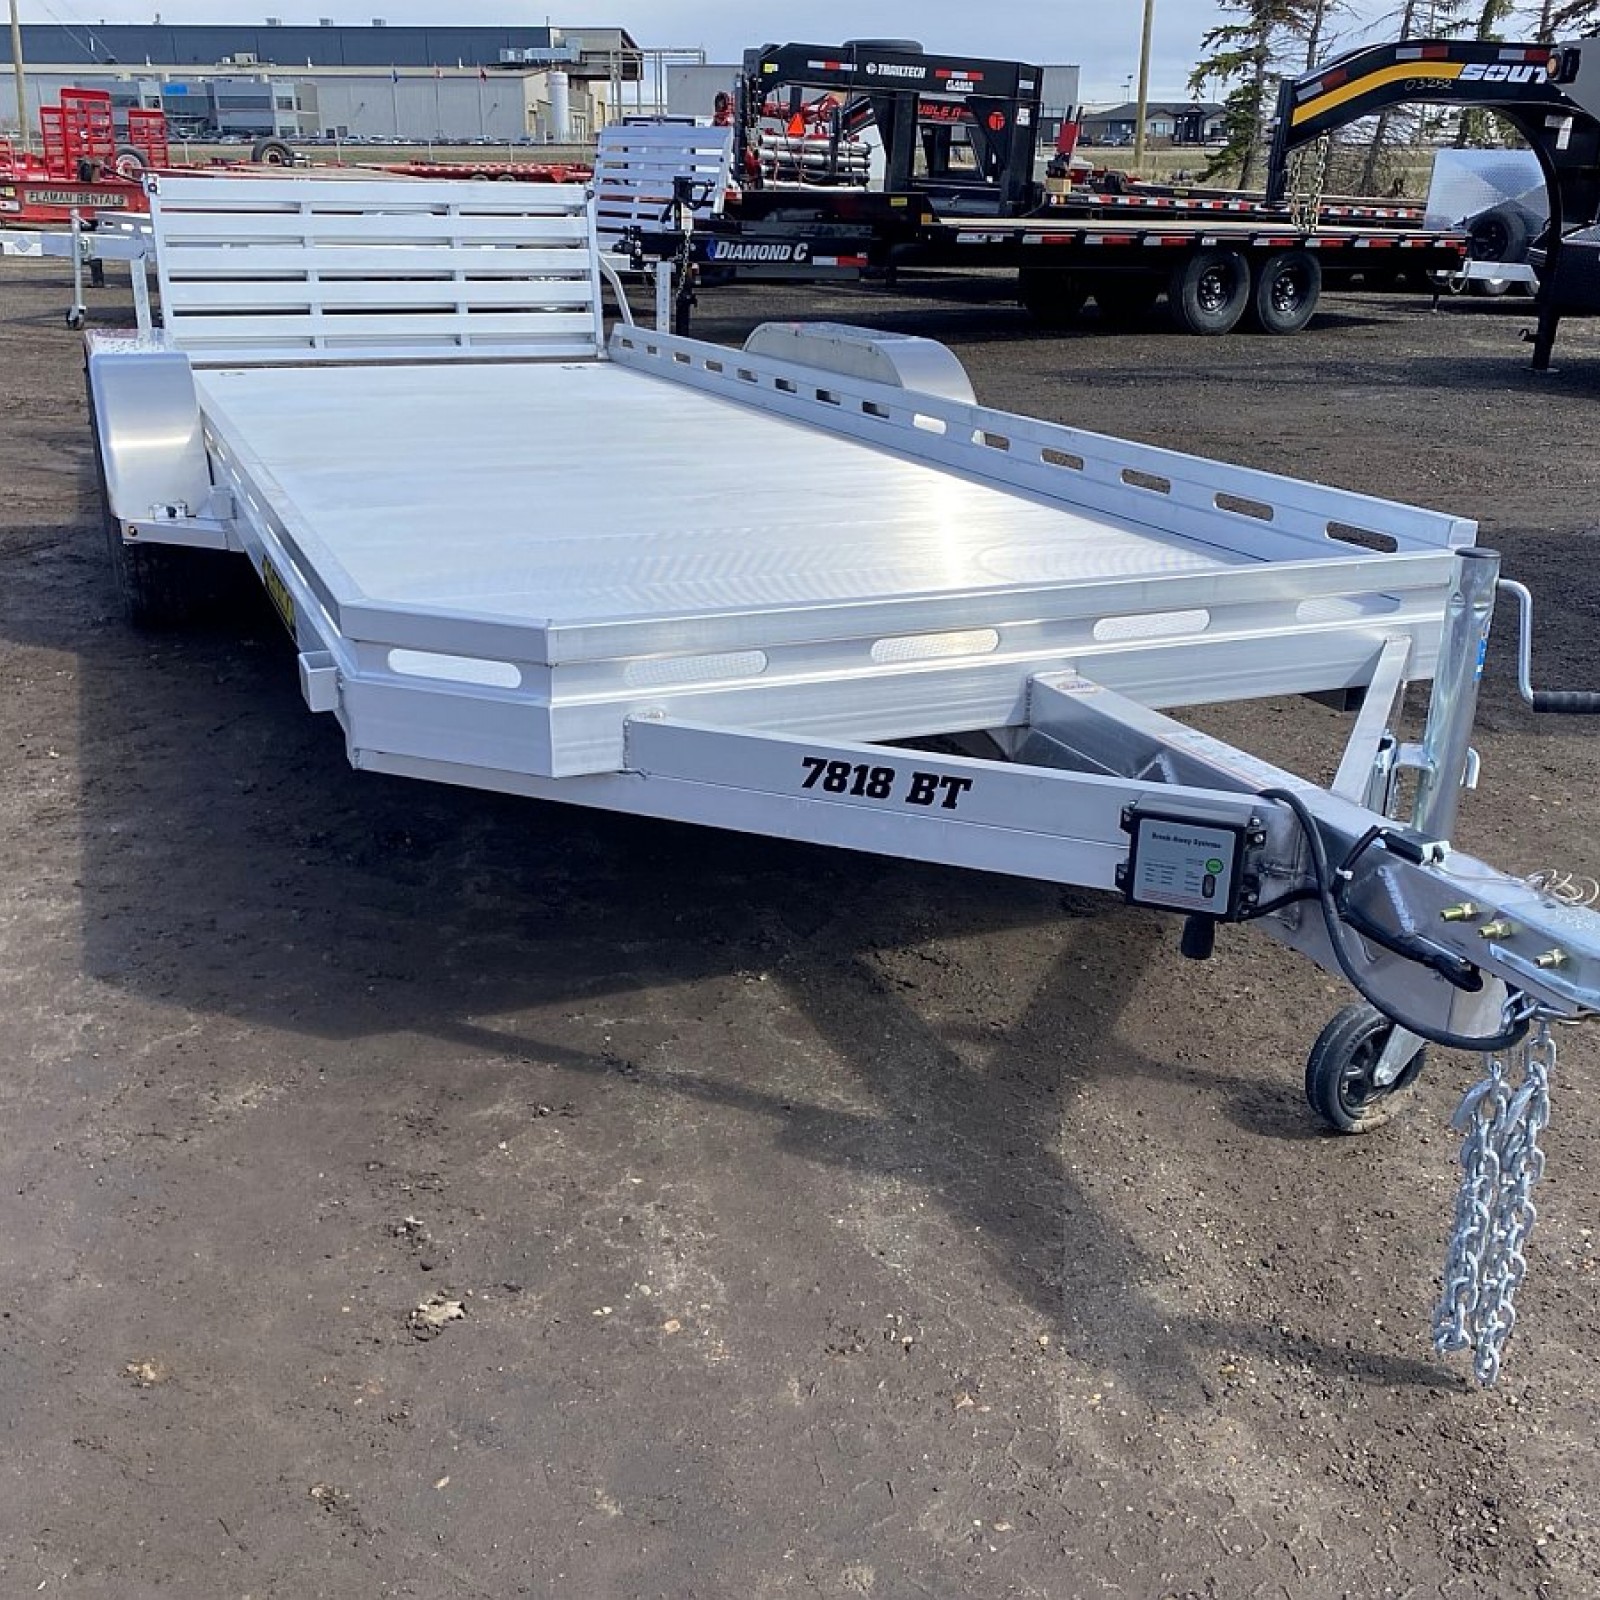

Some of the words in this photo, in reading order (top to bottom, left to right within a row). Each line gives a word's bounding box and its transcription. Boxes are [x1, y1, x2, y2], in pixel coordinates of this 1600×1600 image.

[30, 191, 72, 201] FLAMAN
[77, 193, 124, 205] RENTALS
[794, 243, 808, 261] C
[802, 757, 895, 799] 7818
[905, 771, 973, 809] BT
